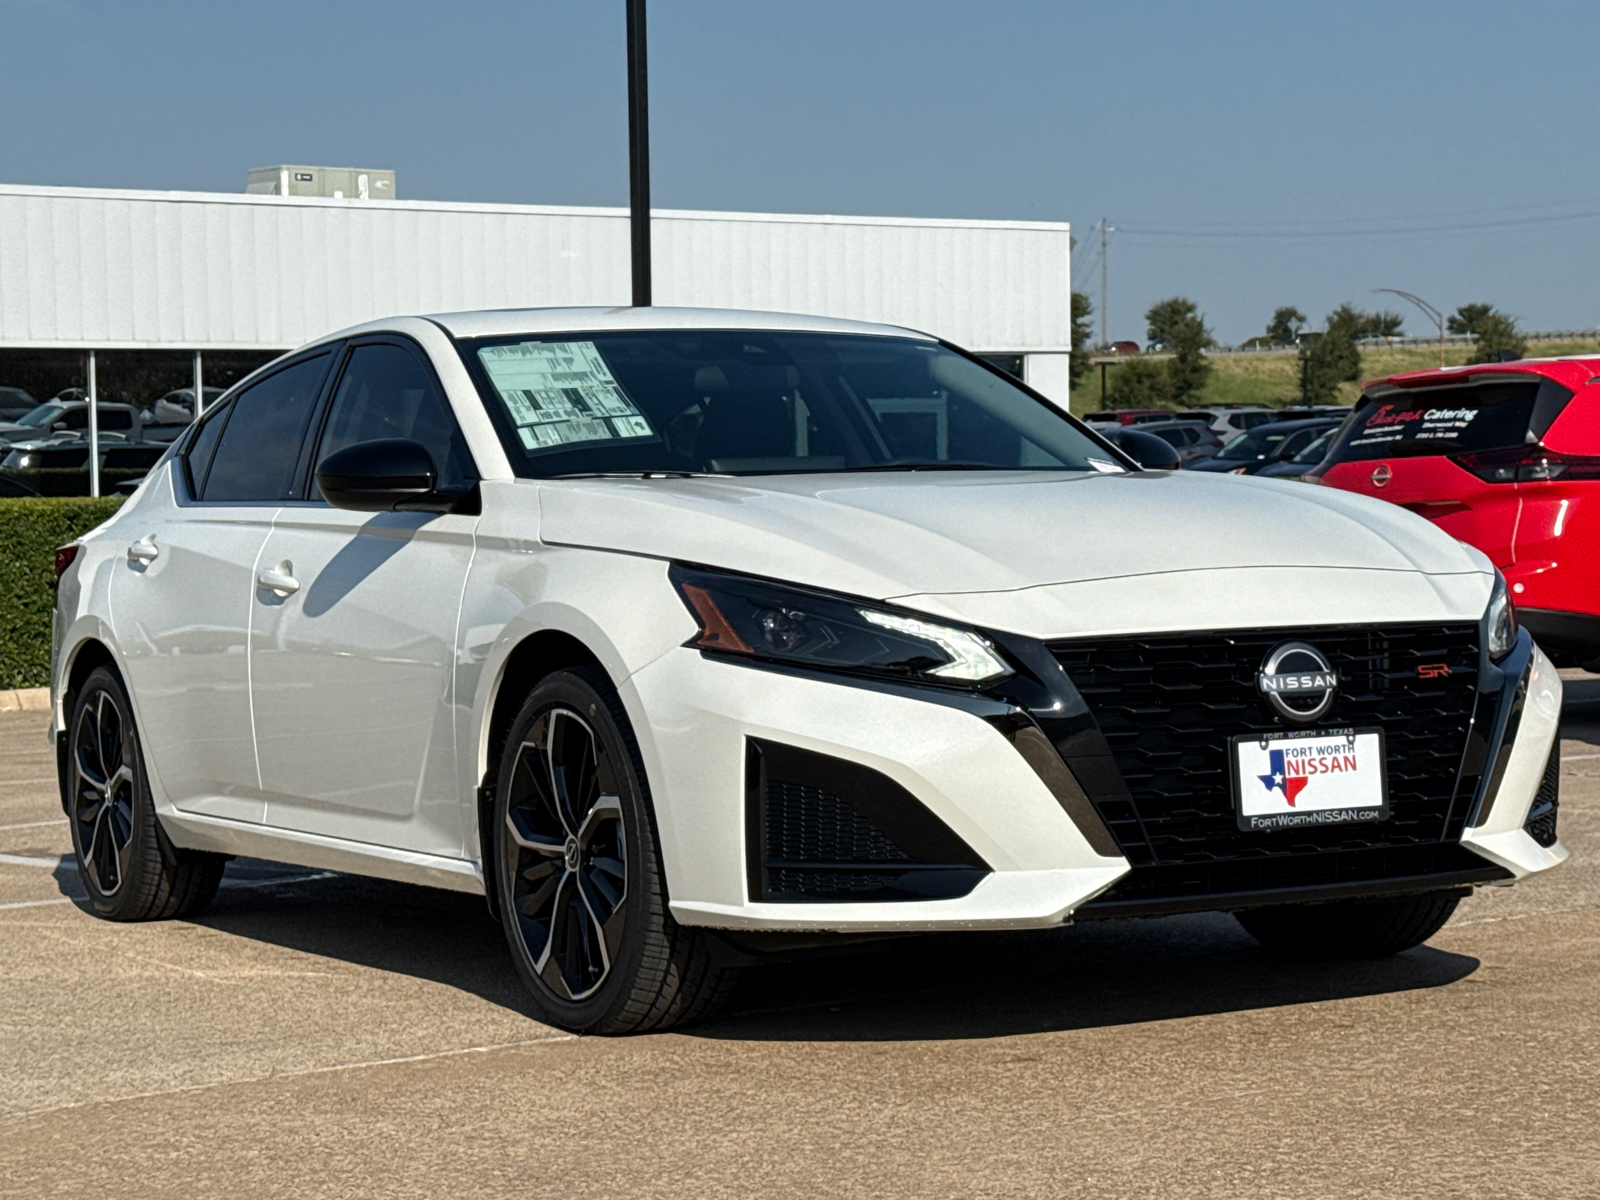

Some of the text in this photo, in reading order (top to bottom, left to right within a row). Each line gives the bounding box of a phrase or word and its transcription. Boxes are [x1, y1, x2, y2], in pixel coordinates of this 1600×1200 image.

[1423, 407, 1479, 421] Catering
[1417, 663, 1449, 678] SR
[1262, 674, 1337, 690] NISSAN
[1263, 728, 1354, 740] FORT WORTH TEXAS
[1285, 743, 1356, 758] FORT WORTH
[1286, 754, 1358, 776] NISSAN
